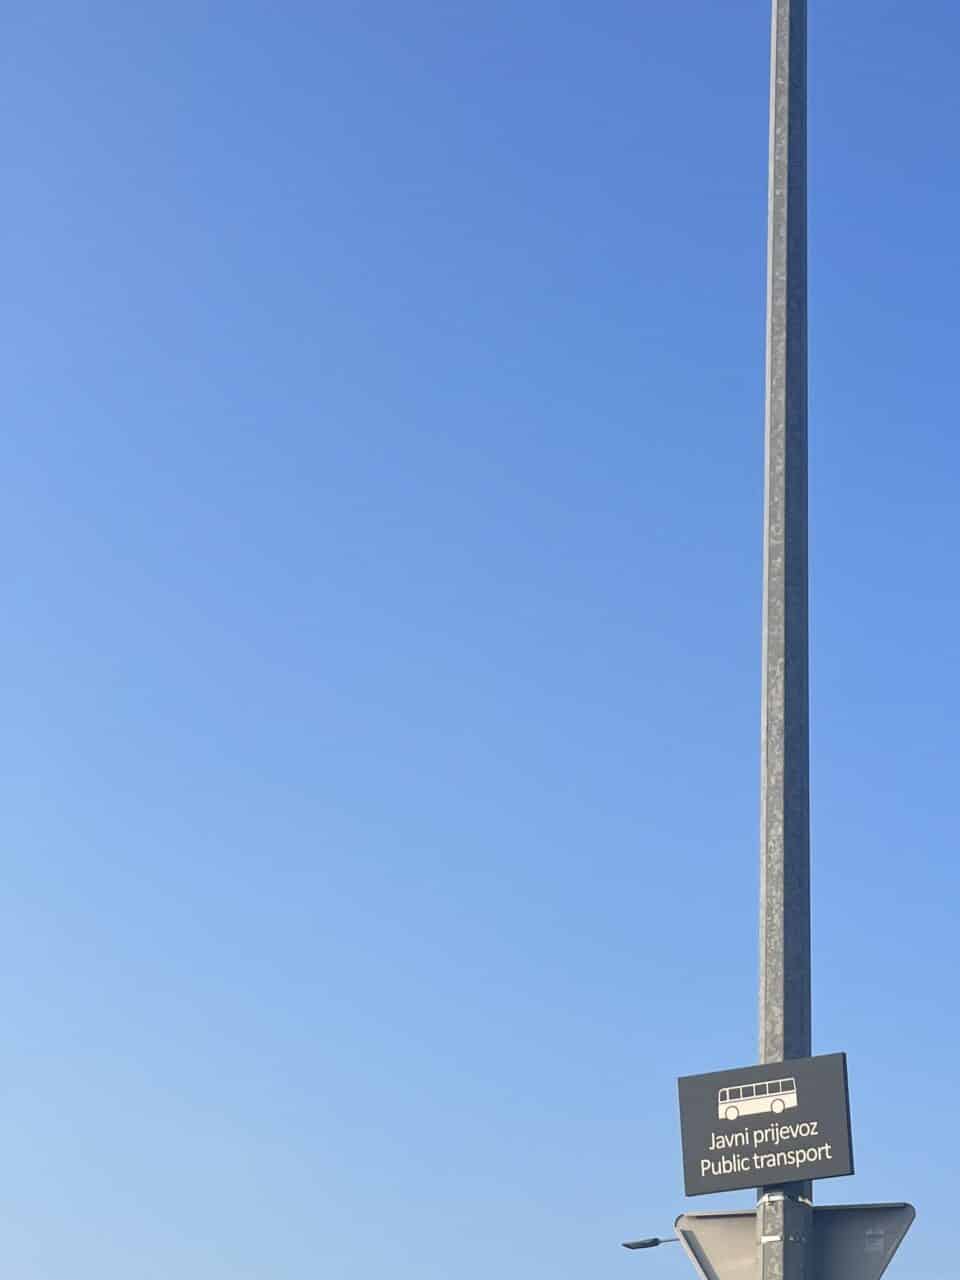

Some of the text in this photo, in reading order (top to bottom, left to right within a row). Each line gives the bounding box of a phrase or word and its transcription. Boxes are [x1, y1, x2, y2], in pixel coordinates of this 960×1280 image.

[709, 1121, 819, 1151] Javni prijevoz
[700, 1142, 833, 1177] Public transport
